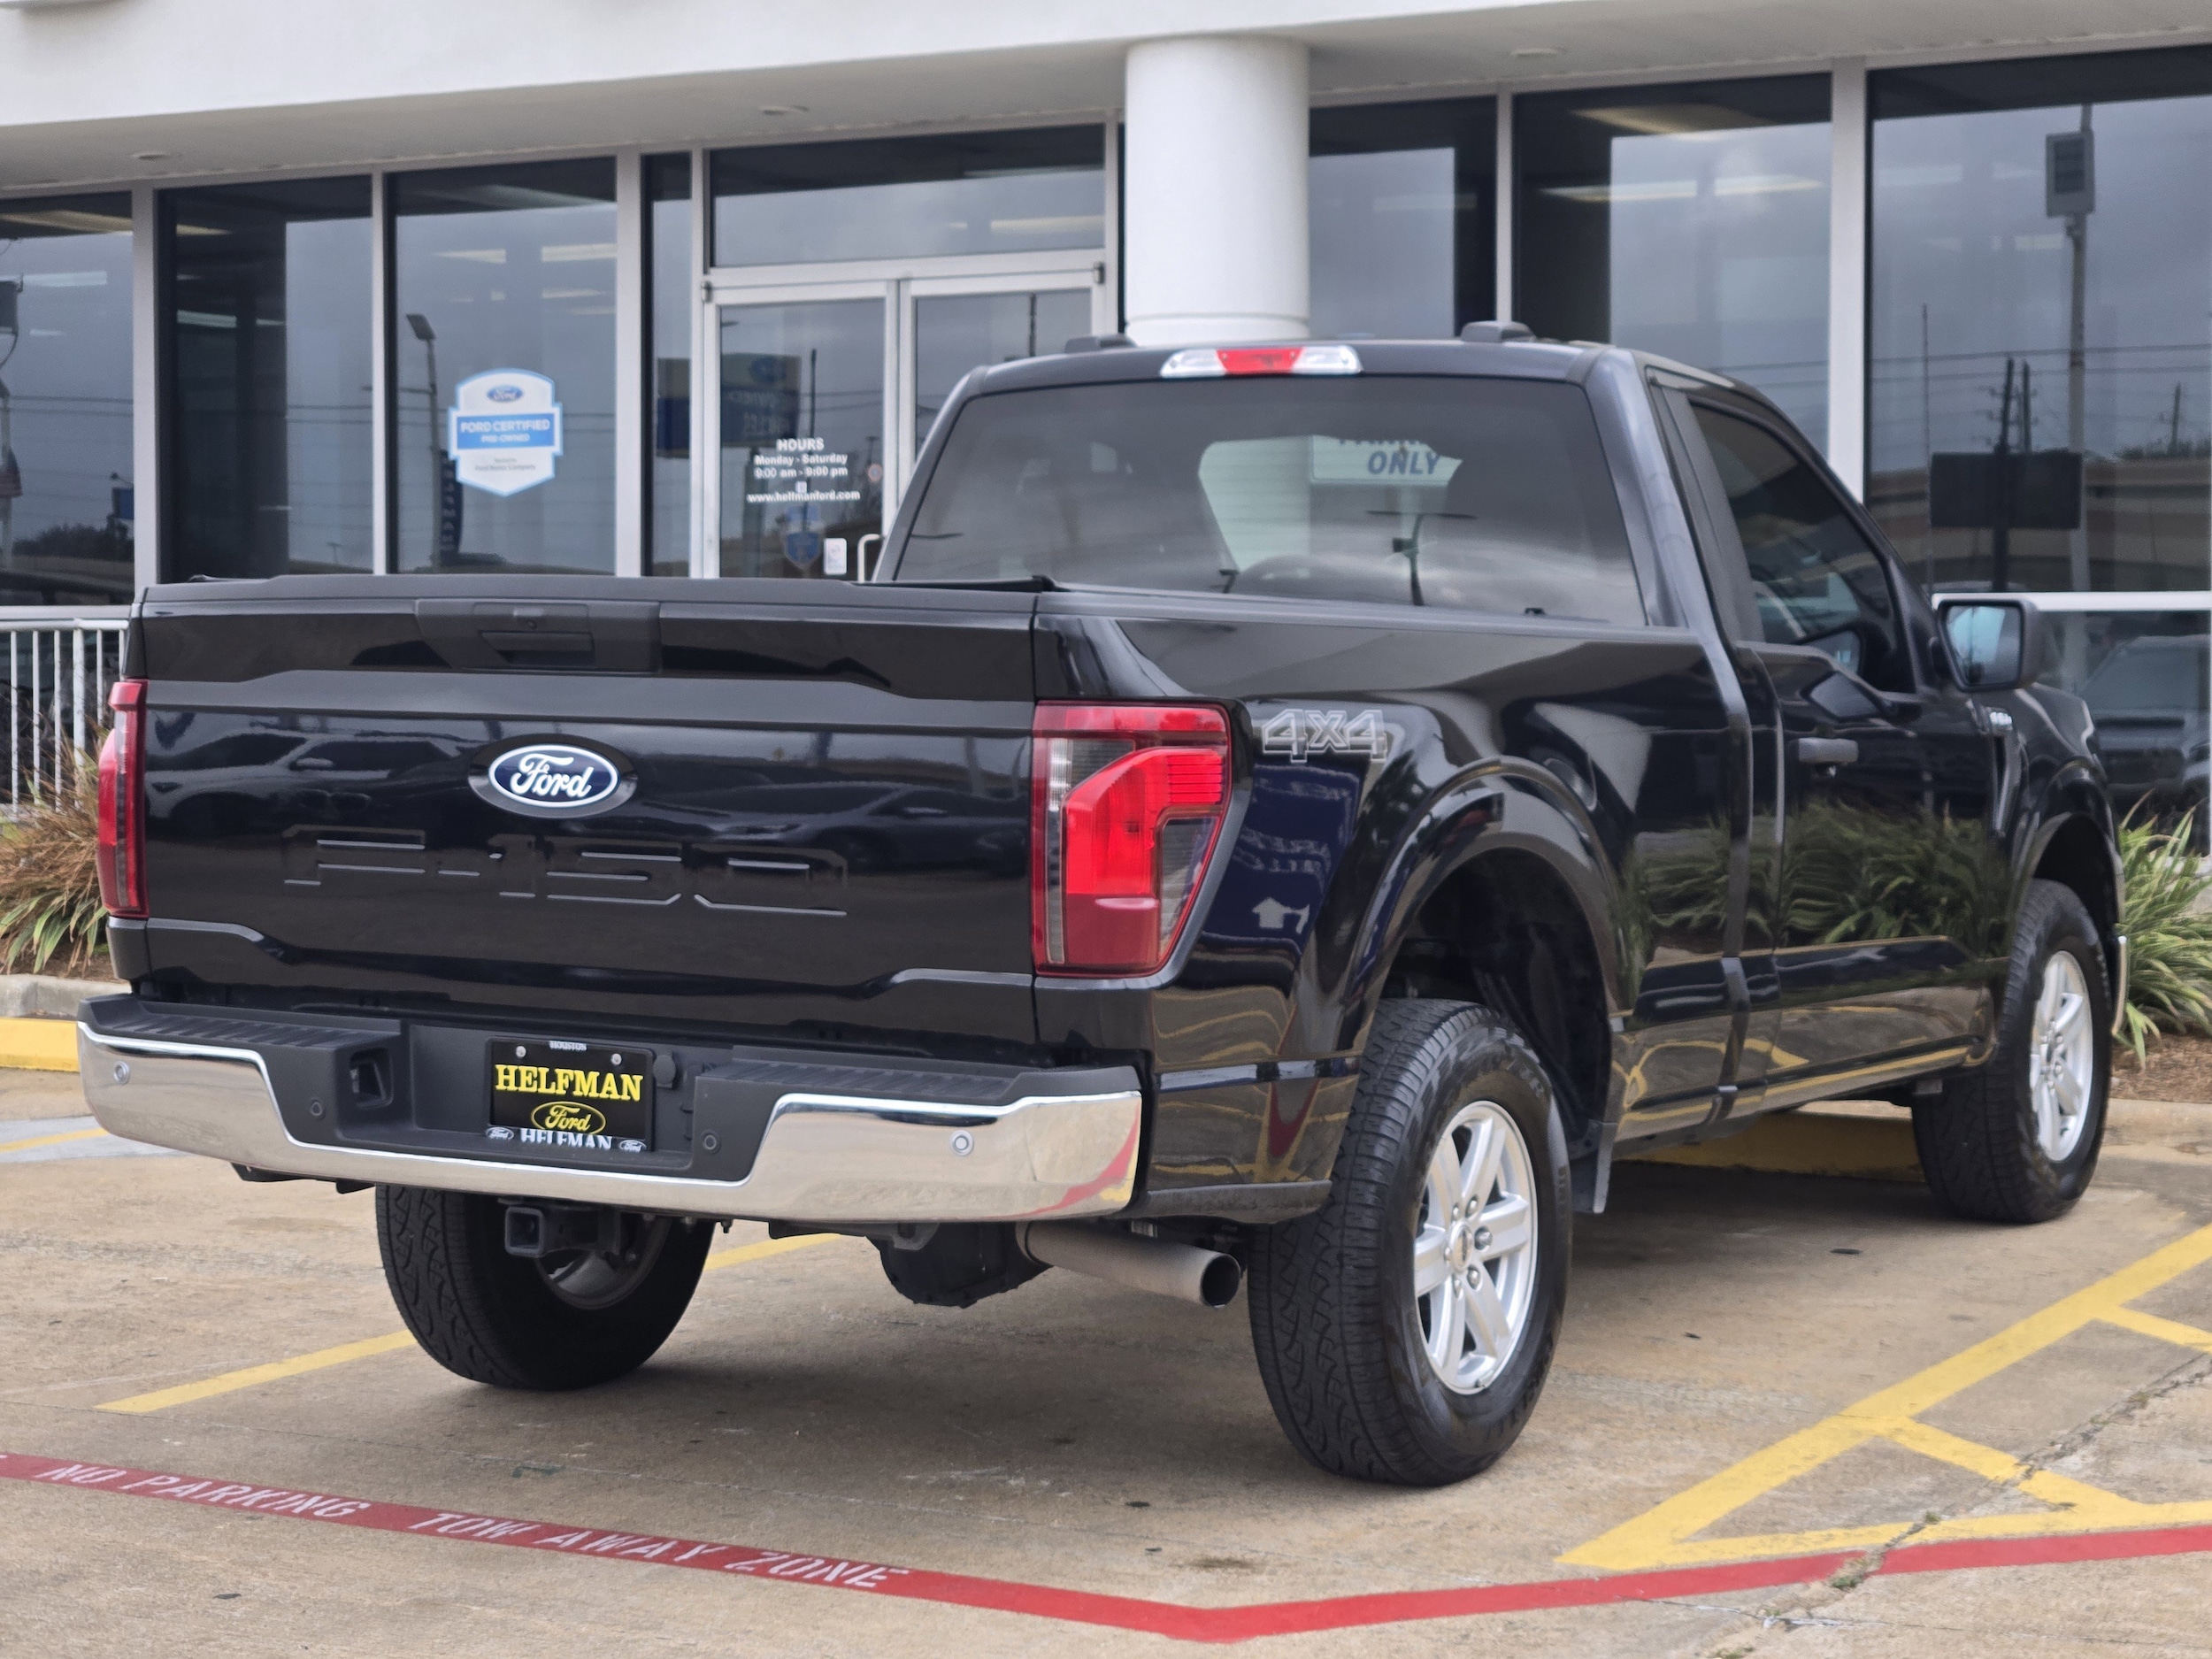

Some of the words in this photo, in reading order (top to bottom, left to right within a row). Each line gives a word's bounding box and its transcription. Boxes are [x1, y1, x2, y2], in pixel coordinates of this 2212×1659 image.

[461, 420, 491, 433] FORD
[493, 419, 550, 432] CERTIFIED
[776, 437, 825, 451] HOURS
[754, 455, 794, 466] Monday
[802, 453, 848, 465] Saturday
[1367, 449, 1440, 476] ONLY
[754, 466, 777, 478] 9:00
[780, 469, 797, 478] am
[806, 466, 828, 477] 9:00
[832, 468, 848, 479] pm
[747, 489, 861, 503] www.helfmanford.com
[510, 753, 594, 797] Ford
[549, 1041, 588, 1051] HOUSTON
[495, 1064, 643, 1102] HELFMAN
[544, 1104, 591, 1132] Ford
[34, 1463, 127, 1484] NO
[119, 1475, 372, 1517] PARKING
[407, 1512, 542, 1540] TOW
[531, 1530, 729, 1562] AWAY
[724, 1551, 910, 1587] ZONE
